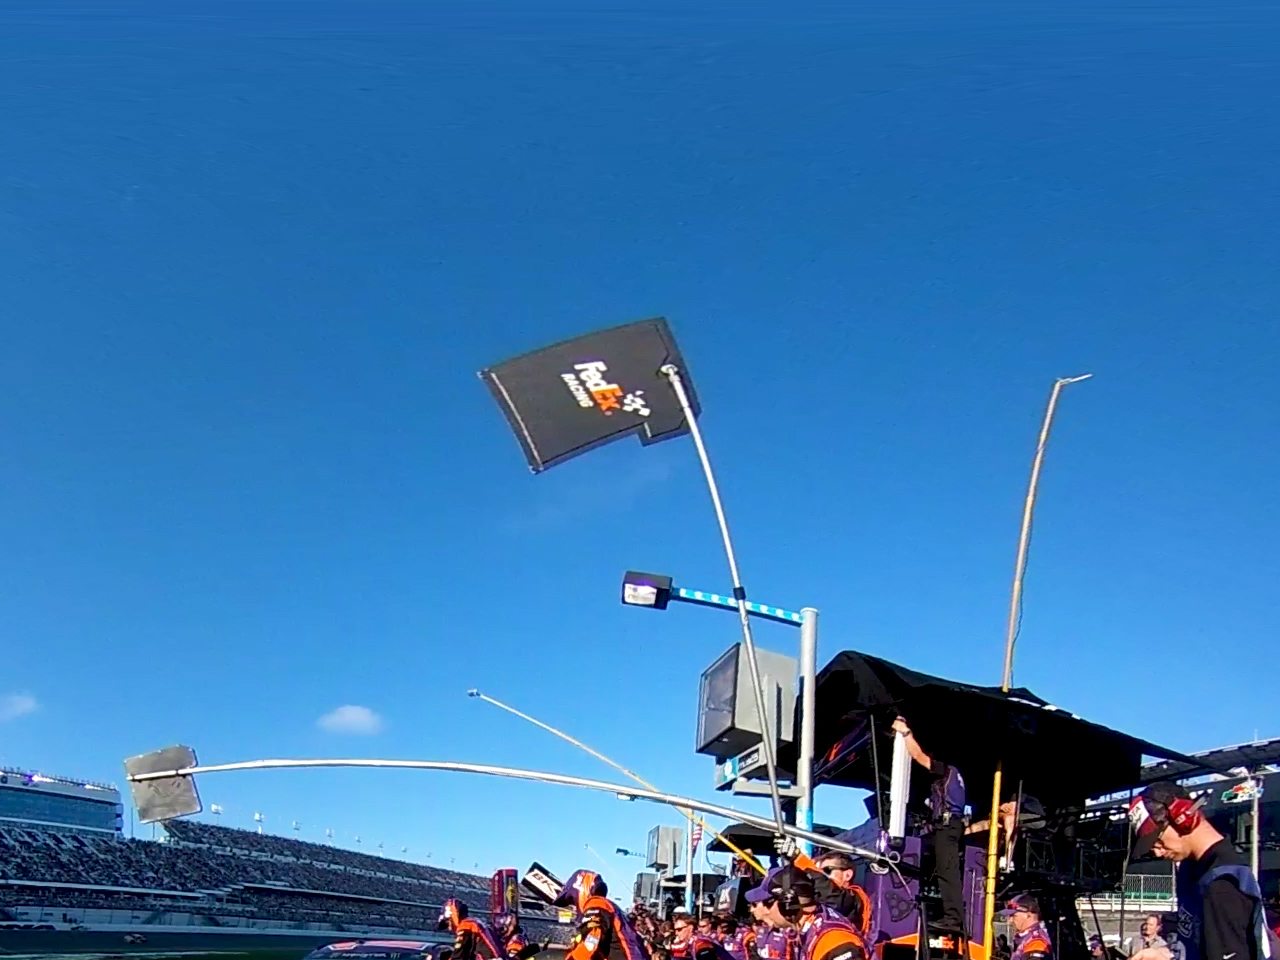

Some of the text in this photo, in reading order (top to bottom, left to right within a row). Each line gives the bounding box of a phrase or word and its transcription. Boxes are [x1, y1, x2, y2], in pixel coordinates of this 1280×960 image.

[561, 372, 594, 408] RACING
[574, 361, 625, 415] FedEx
[928, 936, 954, 949] edEx
